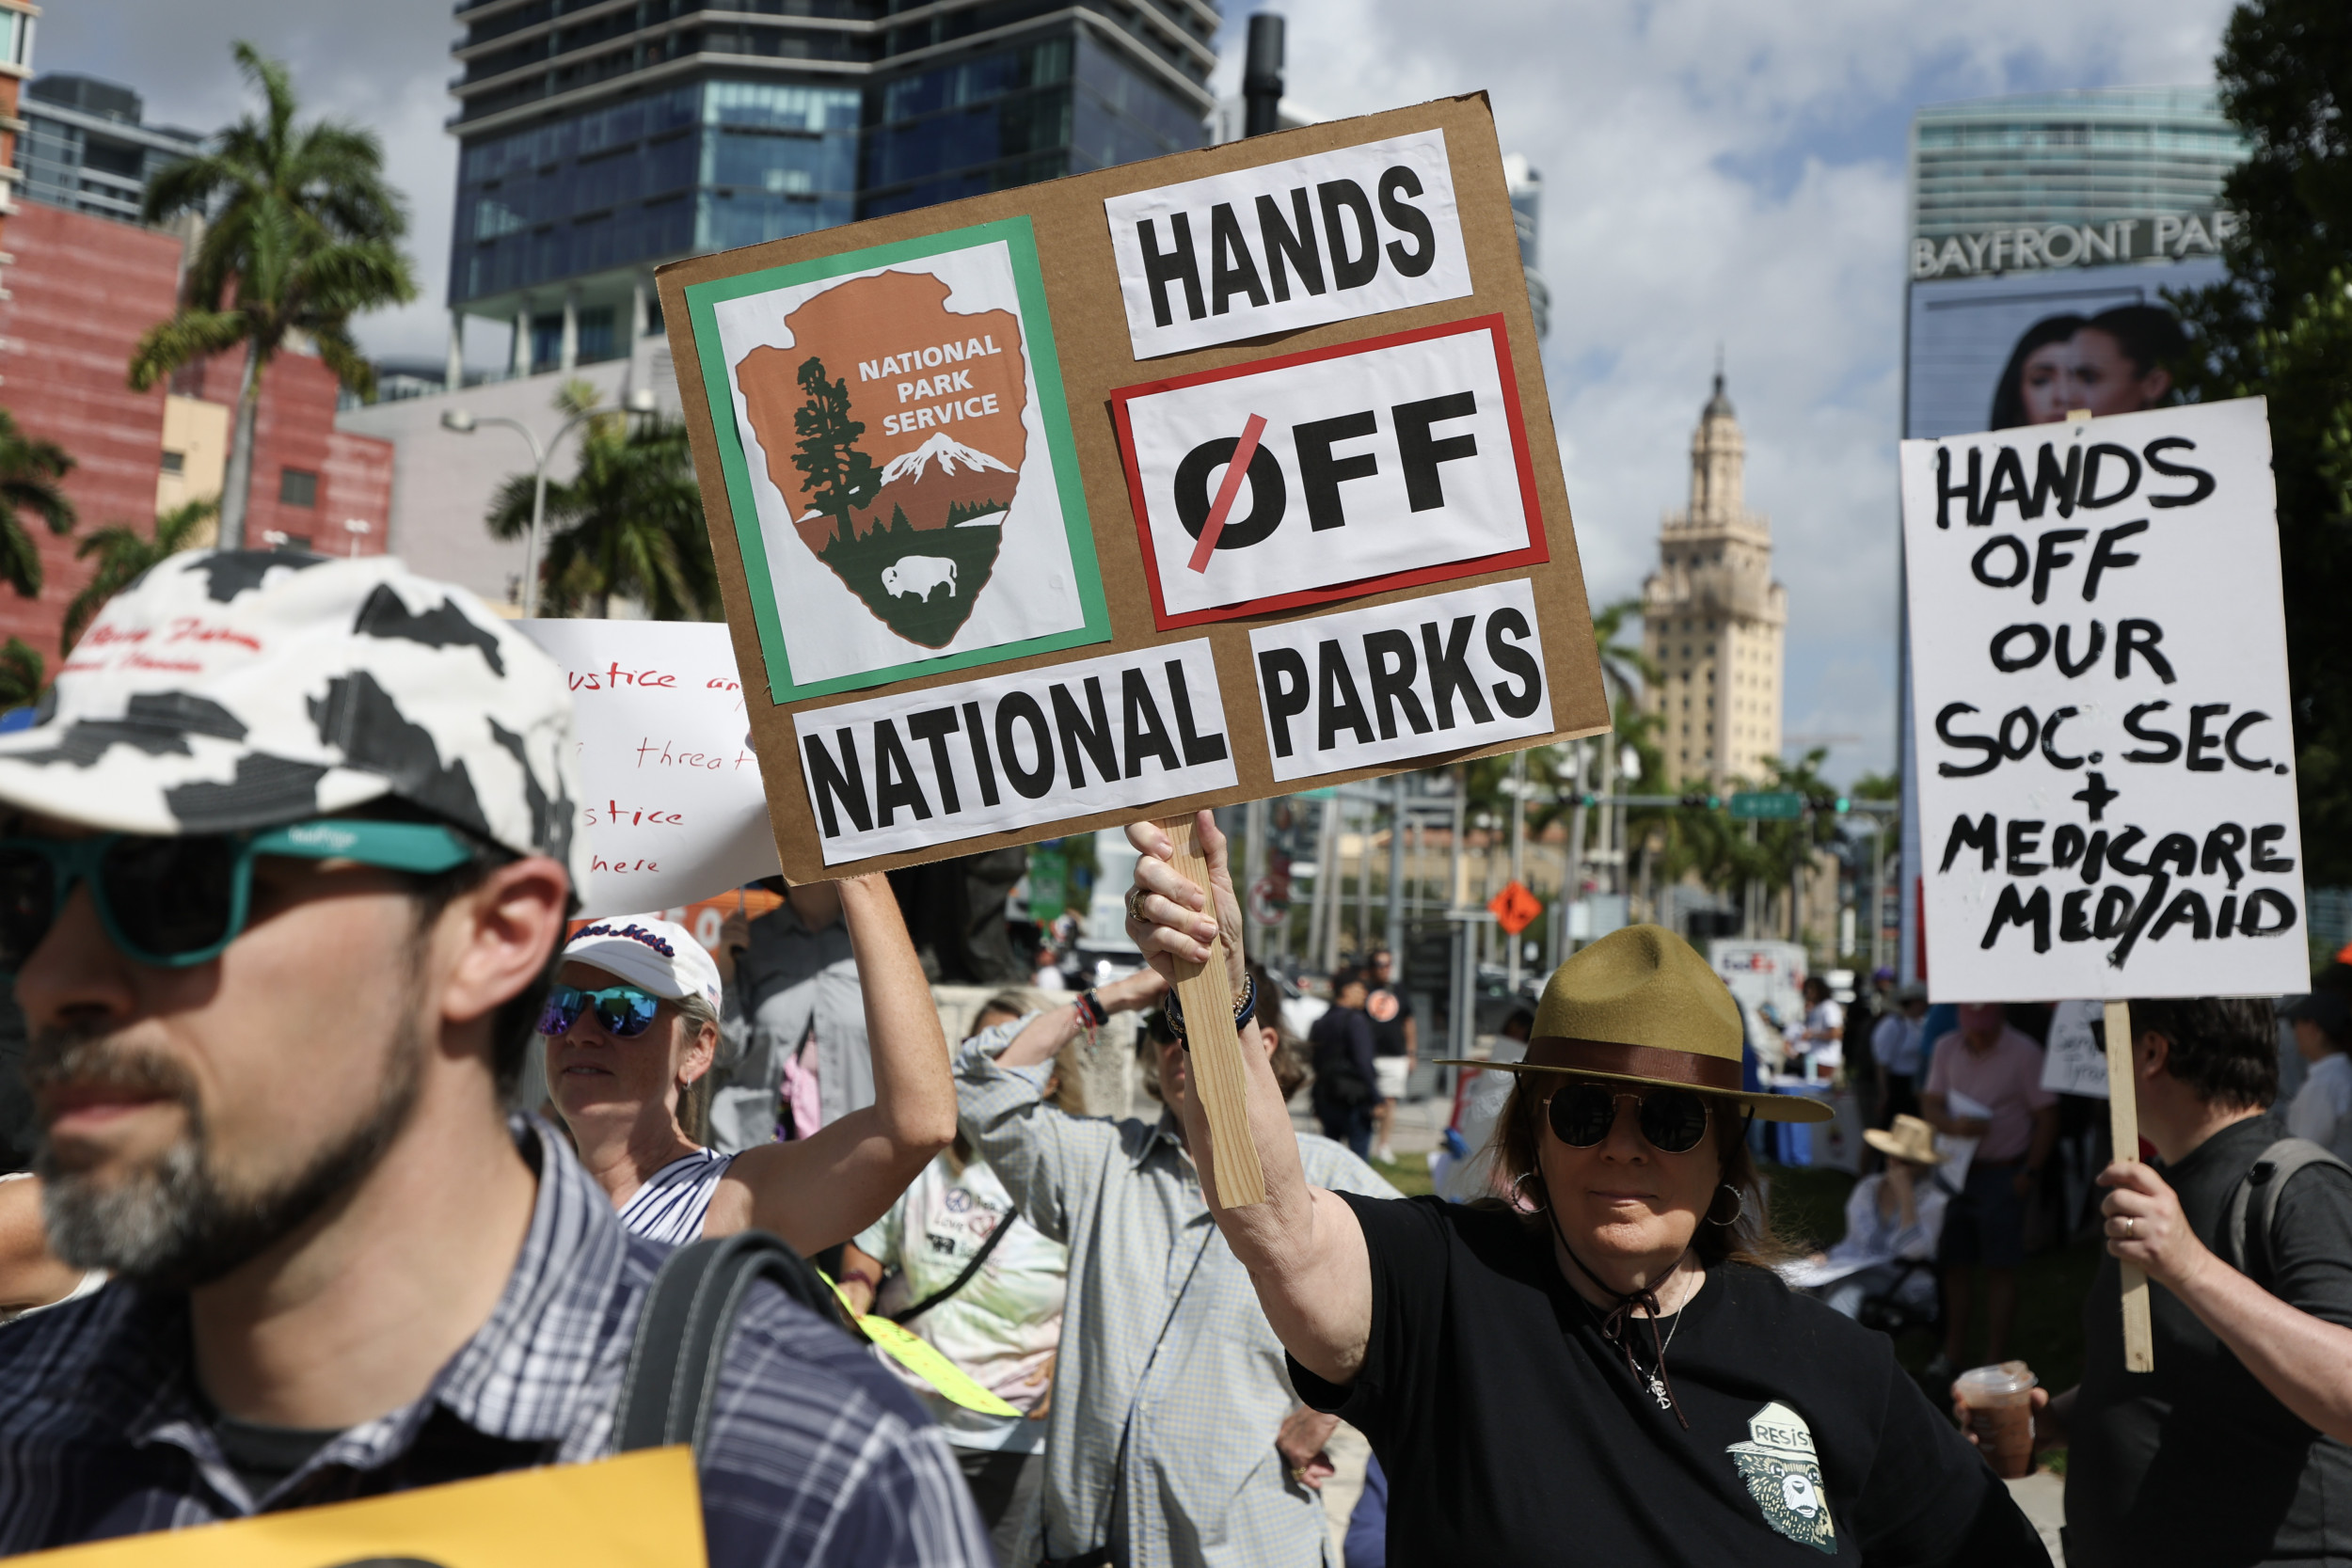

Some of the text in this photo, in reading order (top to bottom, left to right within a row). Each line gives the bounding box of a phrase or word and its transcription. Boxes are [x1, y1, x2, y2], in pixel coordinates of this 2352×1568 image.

[1136, 165, 1436, 327] HANDS
[1912, 211, 2243, 278] BAYFRONT PAR
[858, 335, 1001, 382] NATIONAL
[897, 369, 974, 404] PARK
[882, 393, 1000, 436] SERVICE
[1173, 390, 1478, 550] OFF
[1936, 436, 2217, 529] HANDS
[1971, 519, 2149, 605] OFF
[568, 661, 678, 692] ustice
[1990, 618, 2176, 684] OUR
[636, 736, 757, 770] threat
[803, 607, 1543, 838] NATIONAL PARKS
[1935, 700, 2290, 778] SOC. SEC.
[583, 800, 684, 827] stice
[1939, 812, 2296, 890] MEDICARE
